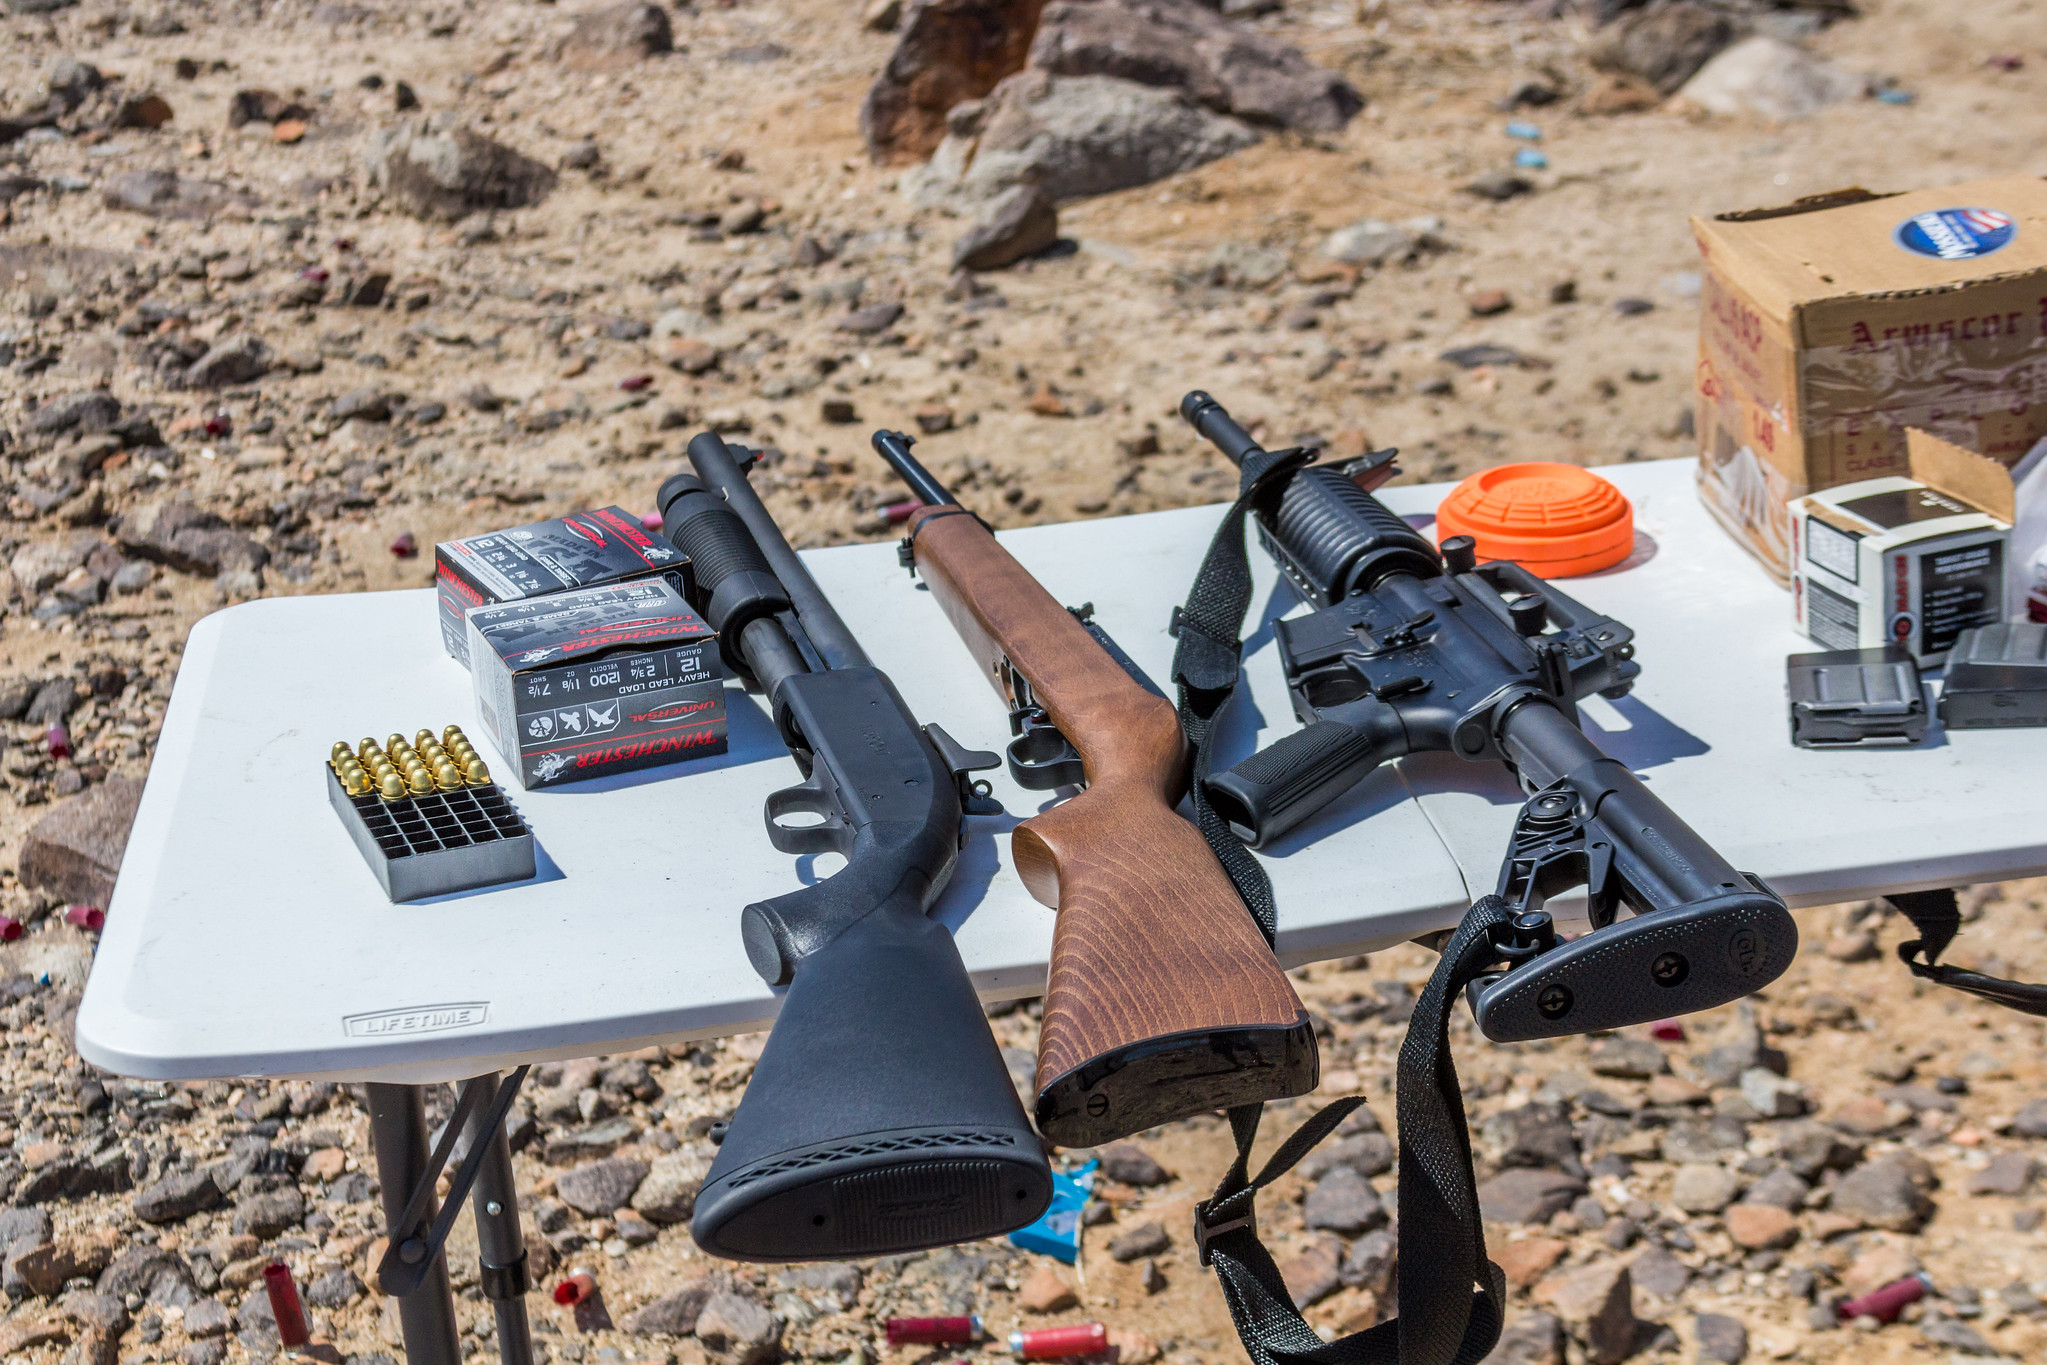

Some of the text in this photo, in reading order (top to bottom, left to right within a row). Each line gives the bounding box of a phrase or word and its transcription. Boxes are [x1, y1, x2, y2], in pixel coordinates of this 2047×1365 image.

[1843, 309, 2022, 354] Armscor
[561, 517, 607, 548] UNIVERSAL
[593, 509, 654, 547] WINCHESTER
[475, 539, 495, 549] 12
[437, 559, 484, 608] WINCHESTER
[1895, 554, 1909, 613] MATCH
[578, 615, 692, 635] UNIVERSAL
[561, 624, 706, 652] WINCHESTER
[630, 656, 654, 666] INCHES
[676, 648, 702, 658] GAUGE
[680, 656, 701, 673] 12
[529, 675, 547, 684] SHOT
[589, 663, 619, 674] VELOCITY
[589, 671, 621, 687] 1200
[618, 671, 710, 694] HEAVY LEAD LOAD
[632, 700, 716, 723] UNIVERSAL
[576, 728, 718, 768] WINCHESTER
[364, 1010, 471, 1033] LIFETIME
